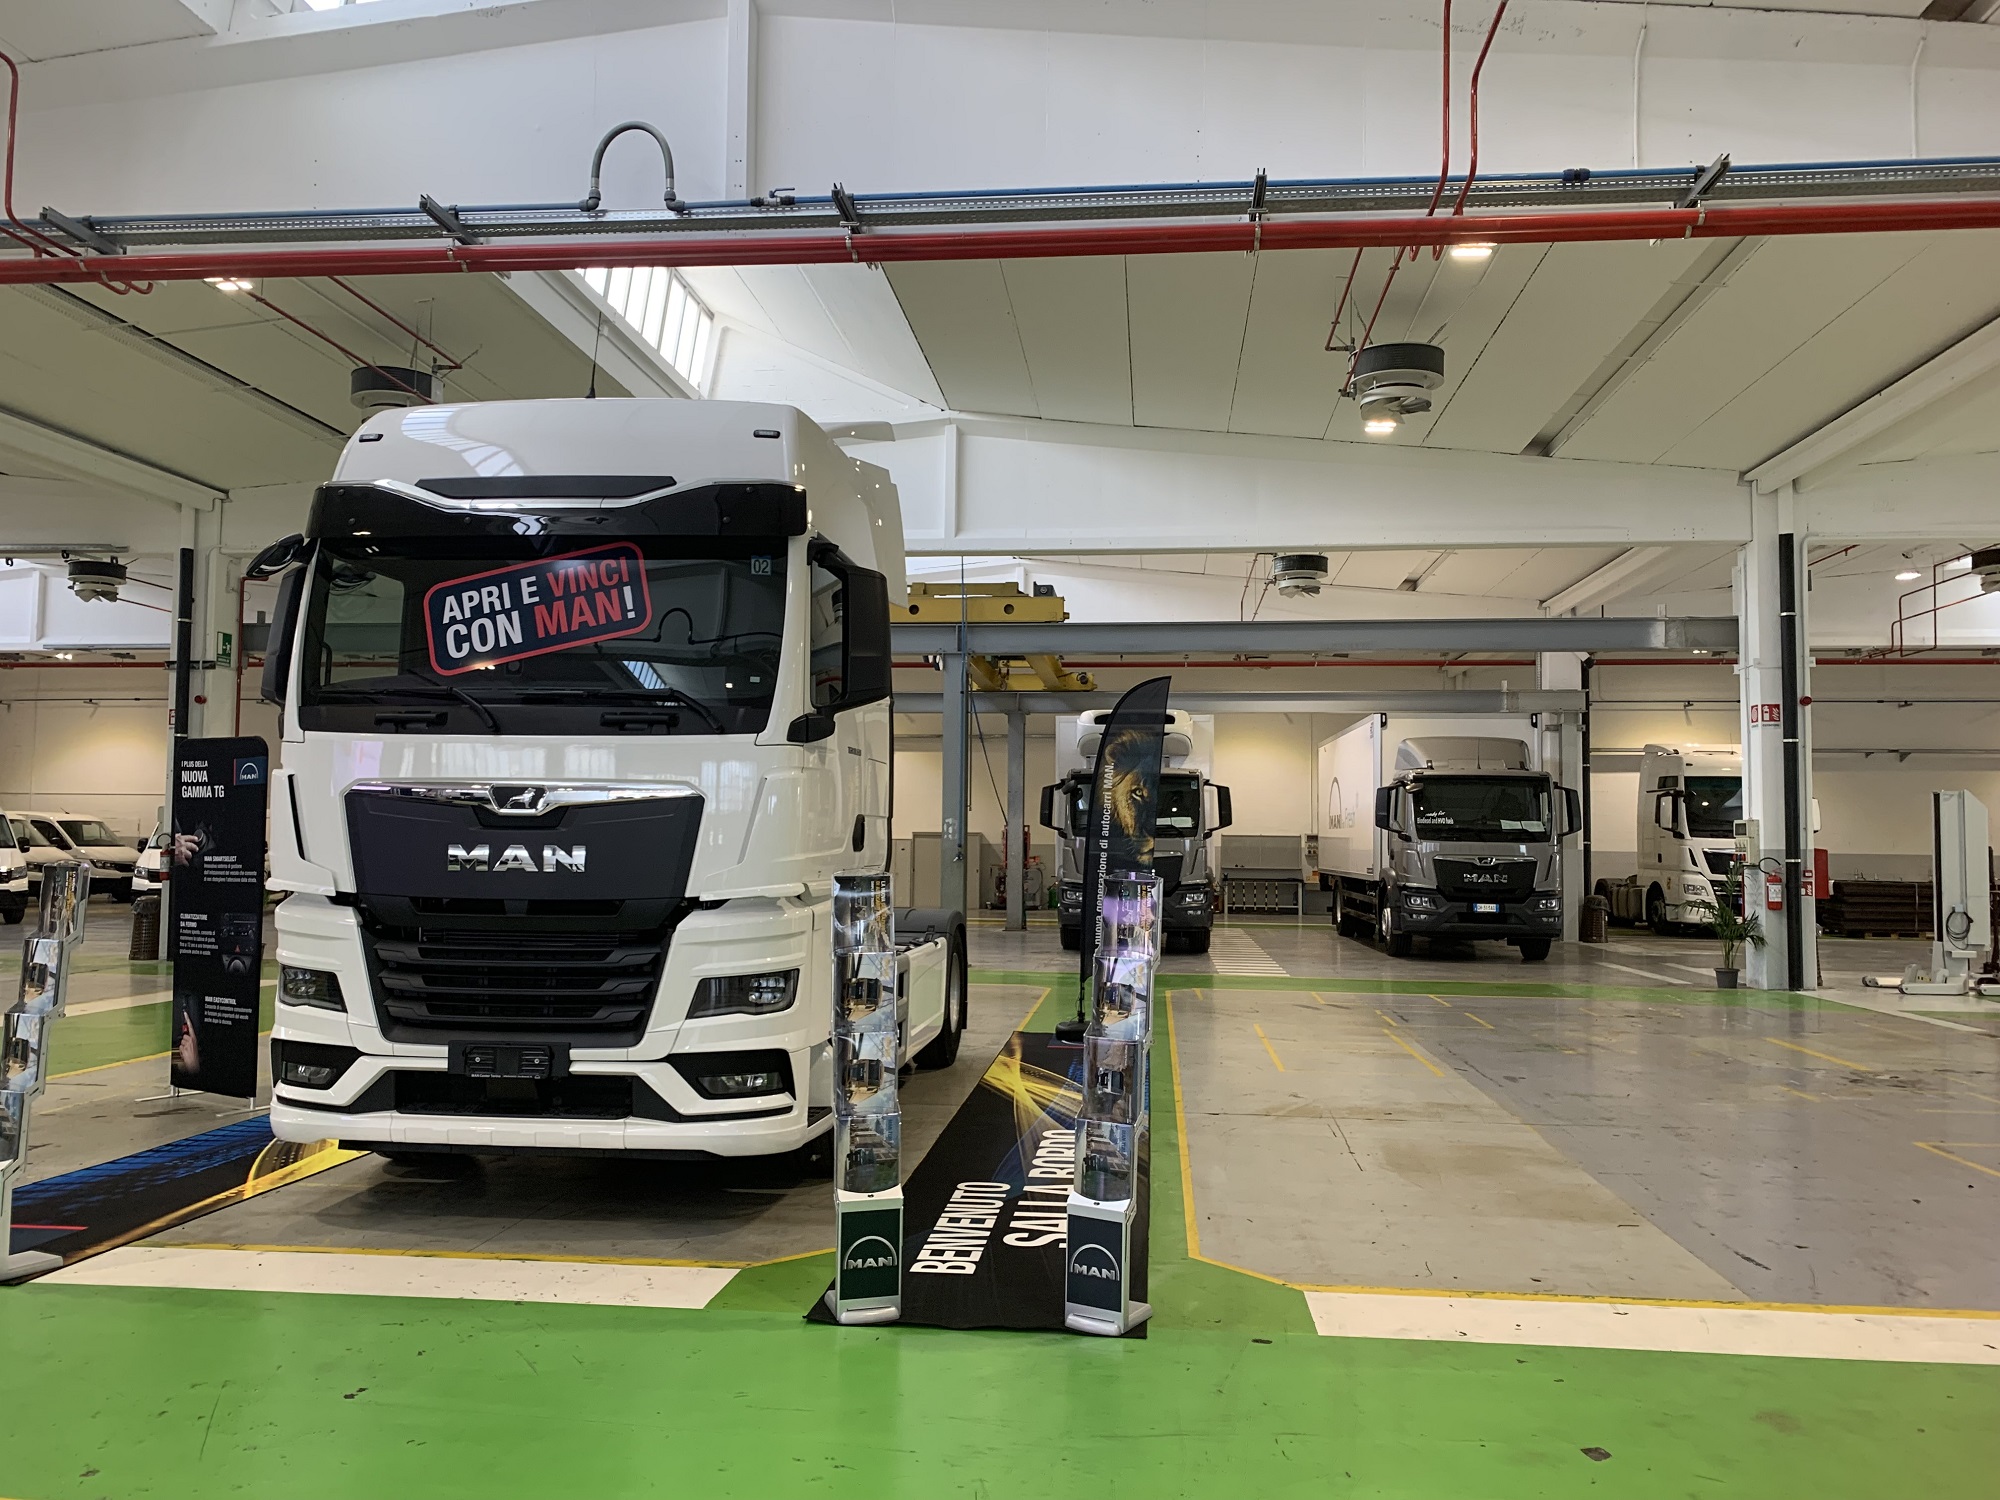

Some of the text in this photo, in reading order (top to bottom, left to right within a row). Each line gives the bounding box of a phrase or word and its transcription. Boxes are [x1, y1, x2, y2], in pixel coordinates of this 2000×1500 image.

[753, 559, 769, 573] 02
[442, 556, 629, 624] APRI E VINCI
[446, 585, 636, 659] CON MAN!
[181, 771, 208, 782] NUOVA
[1103, 762, 1115, 790] MAN.
[181, 785, 225, 798] GAMMA TG
[1101, 790, 1112, 837] autocarri
[1099, 839, 1108, 849] di
[447, 844, 586, 873] MAN
[1463, 873, 1508, 883] MAN
[909, 1181, 1011, 1275] BENVENUTO
[847, 1256, 893, 1270] MAN
[1073, 1263, 1116, 1281] MAN
